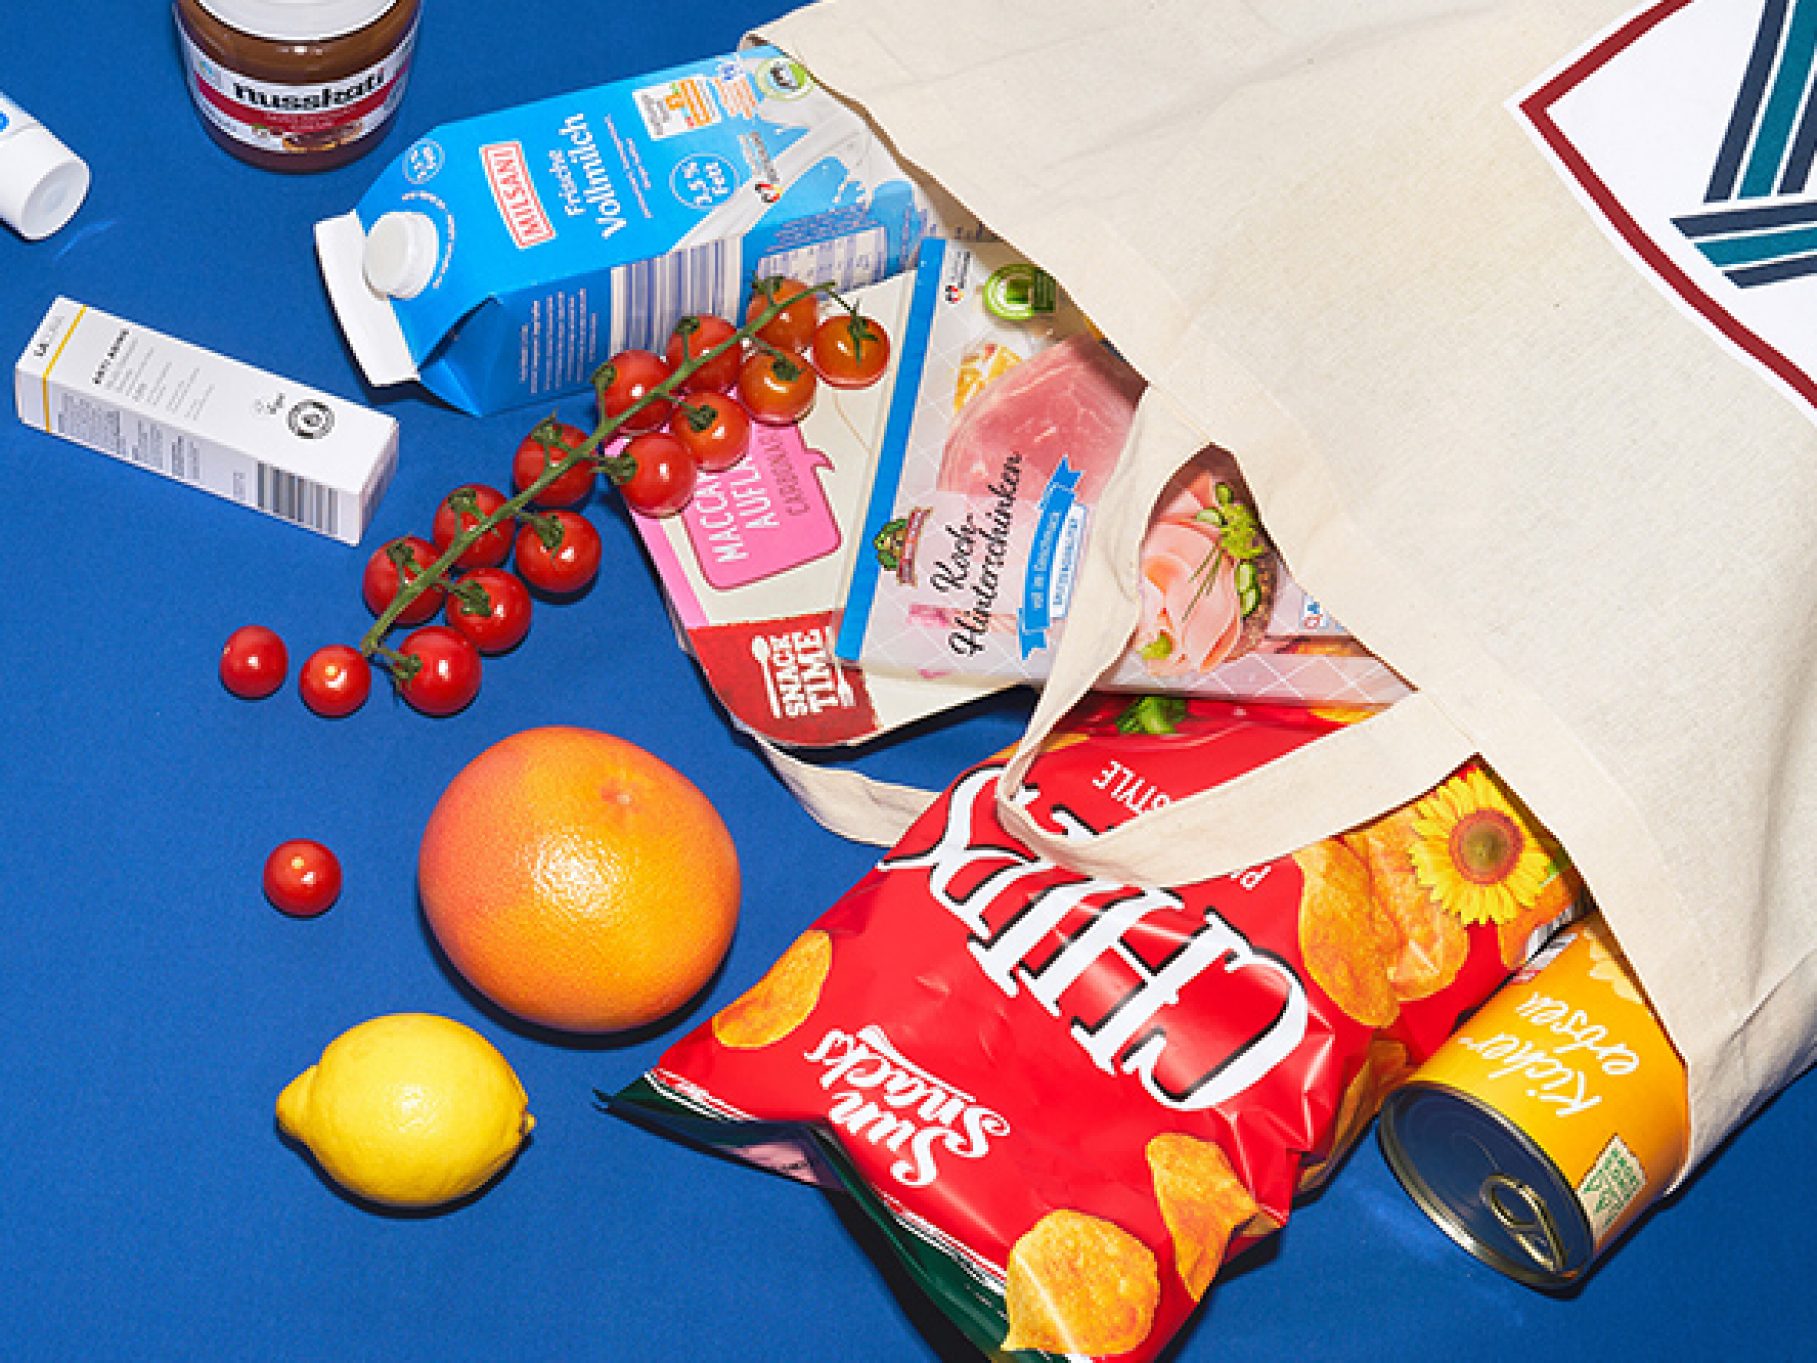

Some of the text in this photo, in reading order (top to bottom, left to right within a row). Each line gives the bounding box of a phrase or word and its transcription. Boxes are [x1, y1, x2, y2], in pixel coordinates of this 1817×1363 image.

[558, 113, 627, 240] Vollmilch
[769, 635, 810, 717] SNACK
[791, 629, 839, 713] TIME
[804, 1025, 1011, 1160] Snacks
[830, 1091, 952, 1187] Sun
